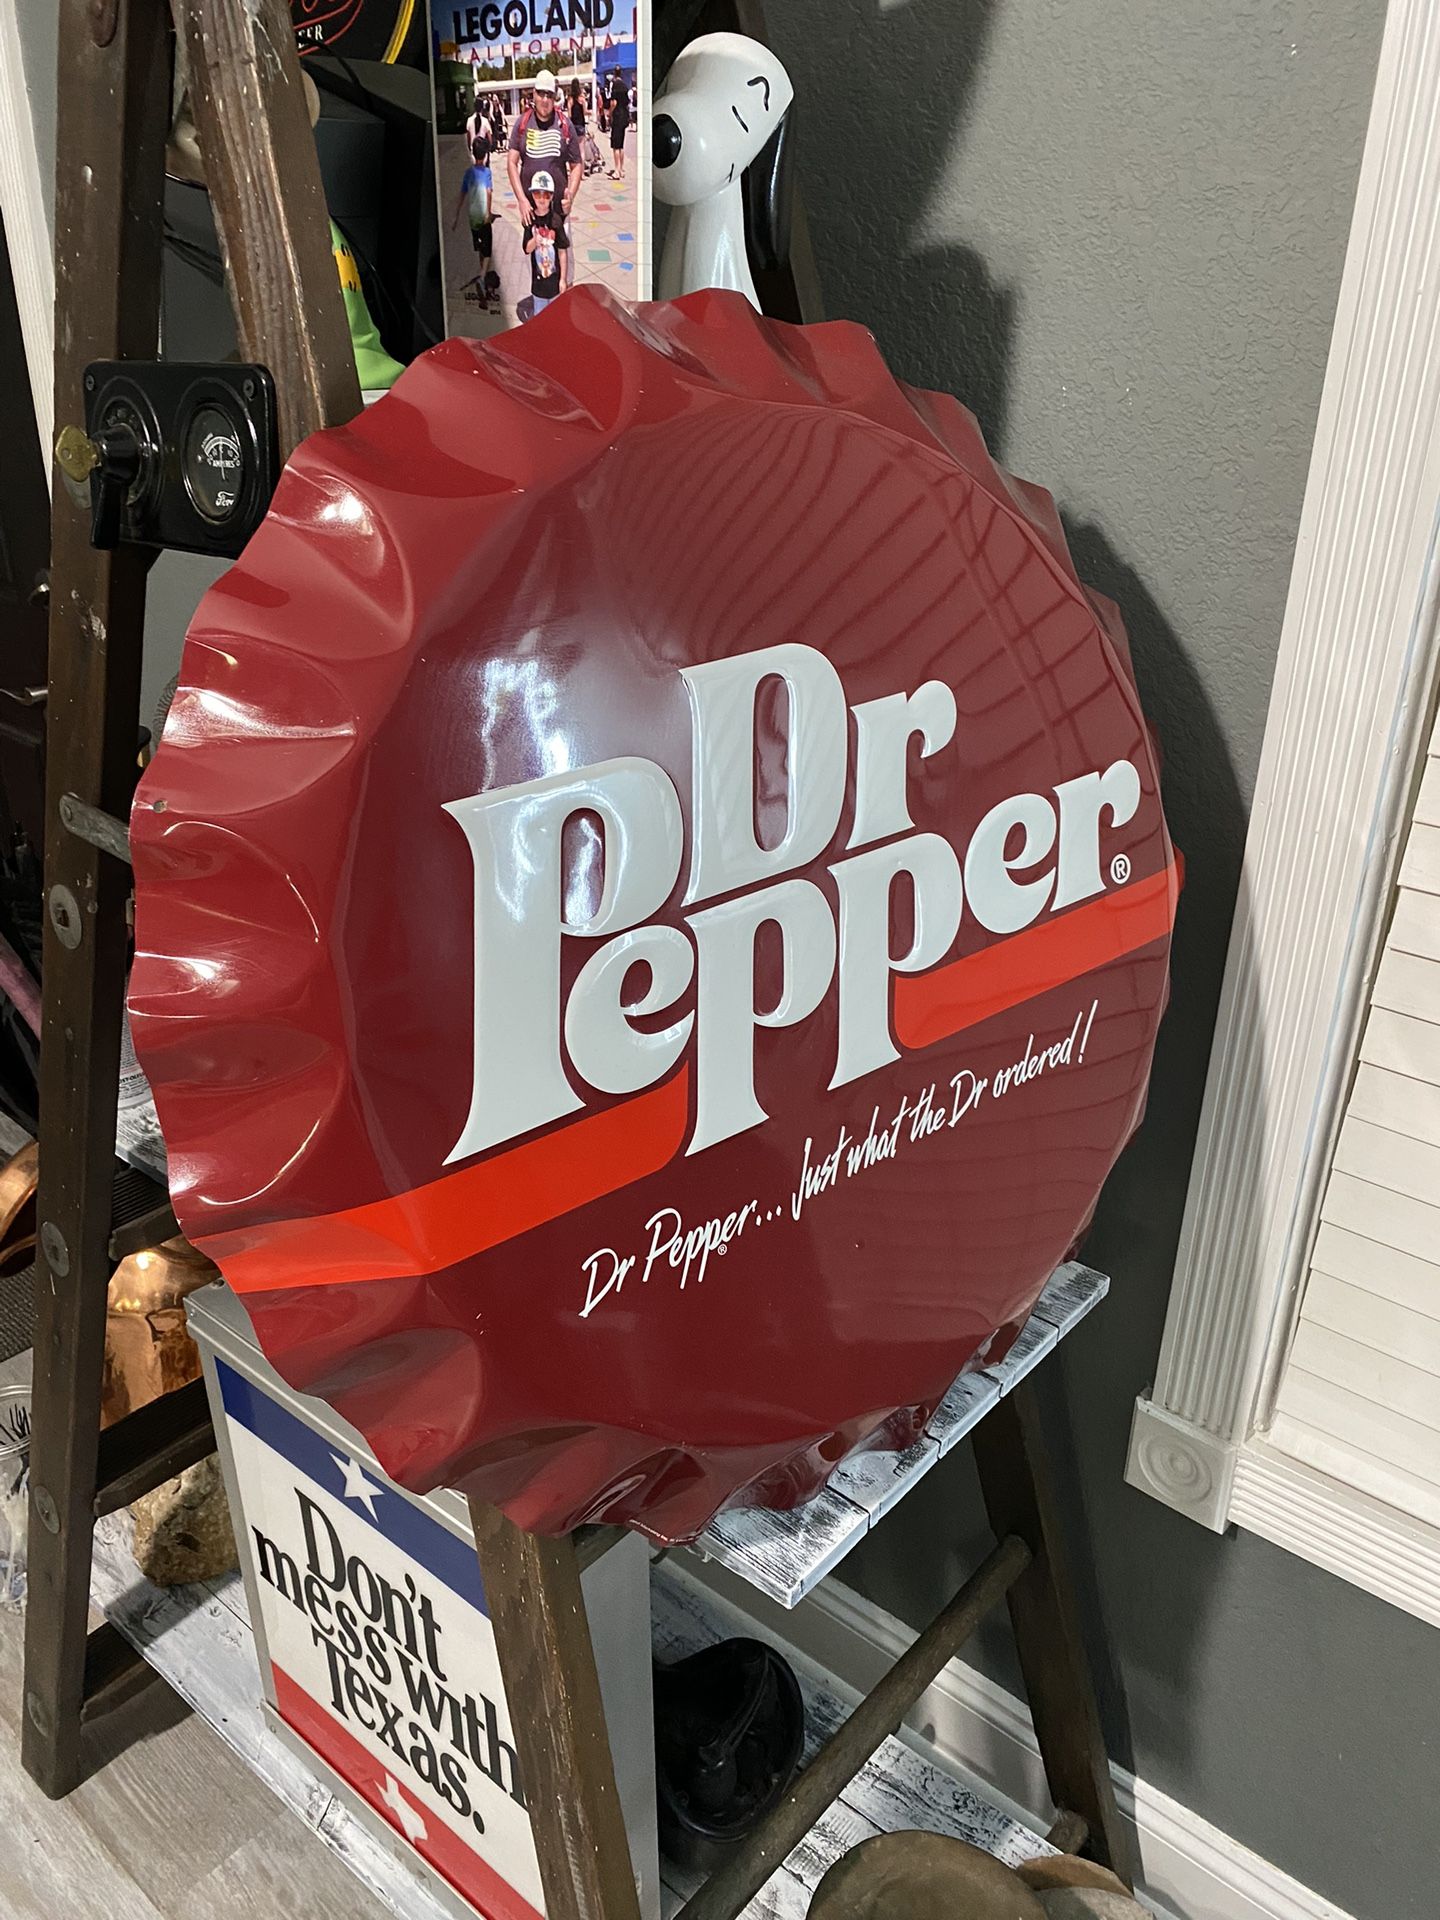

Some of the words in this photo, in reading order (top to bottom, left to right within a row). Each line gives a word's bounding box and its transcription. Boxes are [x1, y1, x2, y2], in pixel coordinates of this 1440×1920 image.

[453, 0, 615, 45] LEGOLAND
[456, 32, 615, 65] ALIFORNIA
[680, 643, 957, 906] Dr
[442, 756, 1141, 1167] Pepper
[578, 1247, 636, 1318] Dr
[791, 1125, 853, 1221] Just
[846, 1095, 911, 1178] what
[908, 1083, 946, 1143] the
[947, 1069, 988, 1128] Dr
[251, 1525, 392, 1687] mess
[394, 1646, 528, 1807] with
[294, 1487, 448, 1682] Don't
[312, 1623, 486, 1835] Texas.
